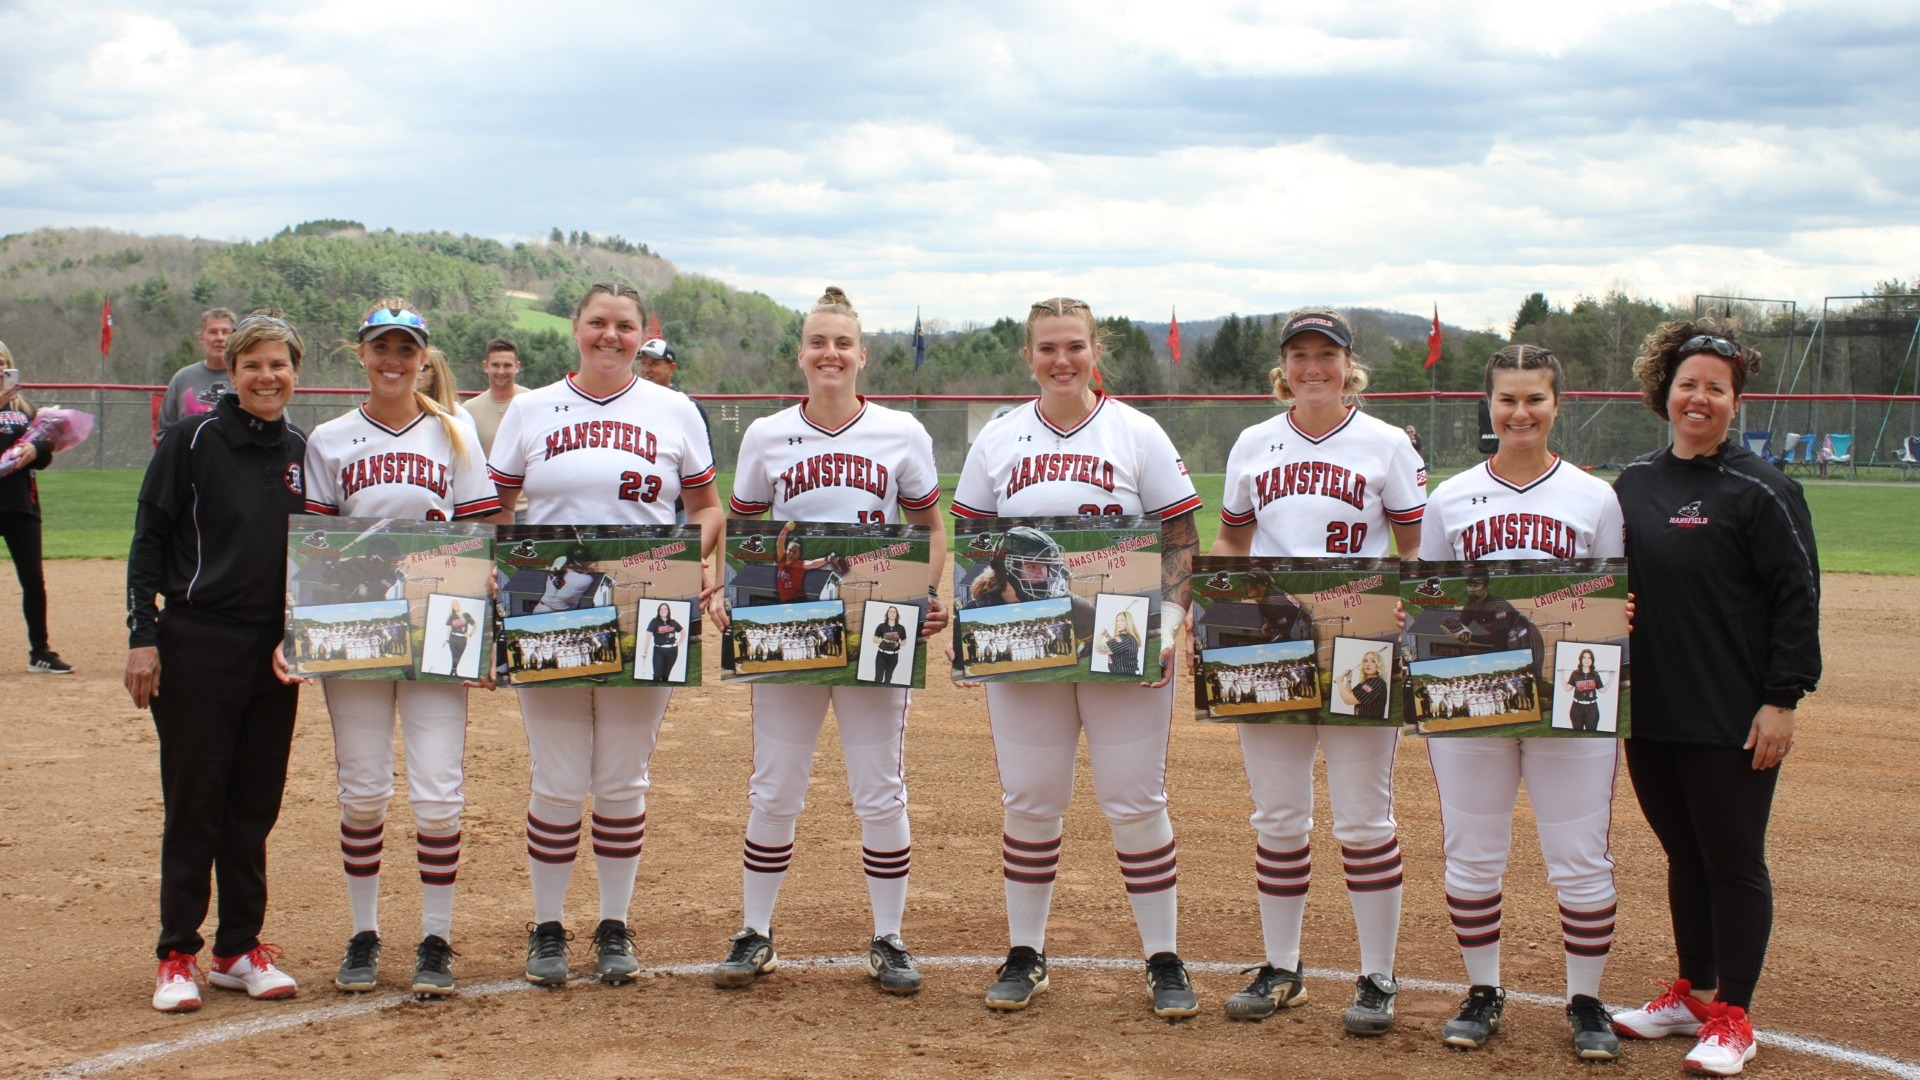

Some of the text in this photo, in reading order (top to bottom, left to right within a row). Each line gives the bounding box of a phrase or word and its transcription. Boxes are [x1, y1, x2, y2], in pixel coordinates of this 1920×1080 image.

[544, 420, 657, 465] MANSFIELD
[342, 452, 448, 500] MANSFIELD
[618, 470, 662, 503] 23
[780, 453, 889, 503] MANSFIELD
[1006, 453, 1115, 500] MANSFIELD
[1255, 461, 1367, 512] MANSFIELD
[1069, 533, 1157, 568] ANASTASIA BERARDI
[1326, 521, 1368, 554] 20
[1462, 513, 1576, 560] MANSFIELD
[410, 548, 440, 564] KAYLA
[444, 557, 457, 569] #8
[621, 541, 686, 568] GABBY DRUMM
[648, 559, 667, 573] #23
[846, 542, 911, 567] DANIELLE GOFF
[873, 560, 892, 574] #12
[1107, 556, 1126, 570] #28
[1314, 585, 1348, 603] FALLON
[1343, 594, 1362, 609] #20
[1533, 575, 1614, 608] LAUREN WATSON
[1571, 598, 1586, 612] #2
